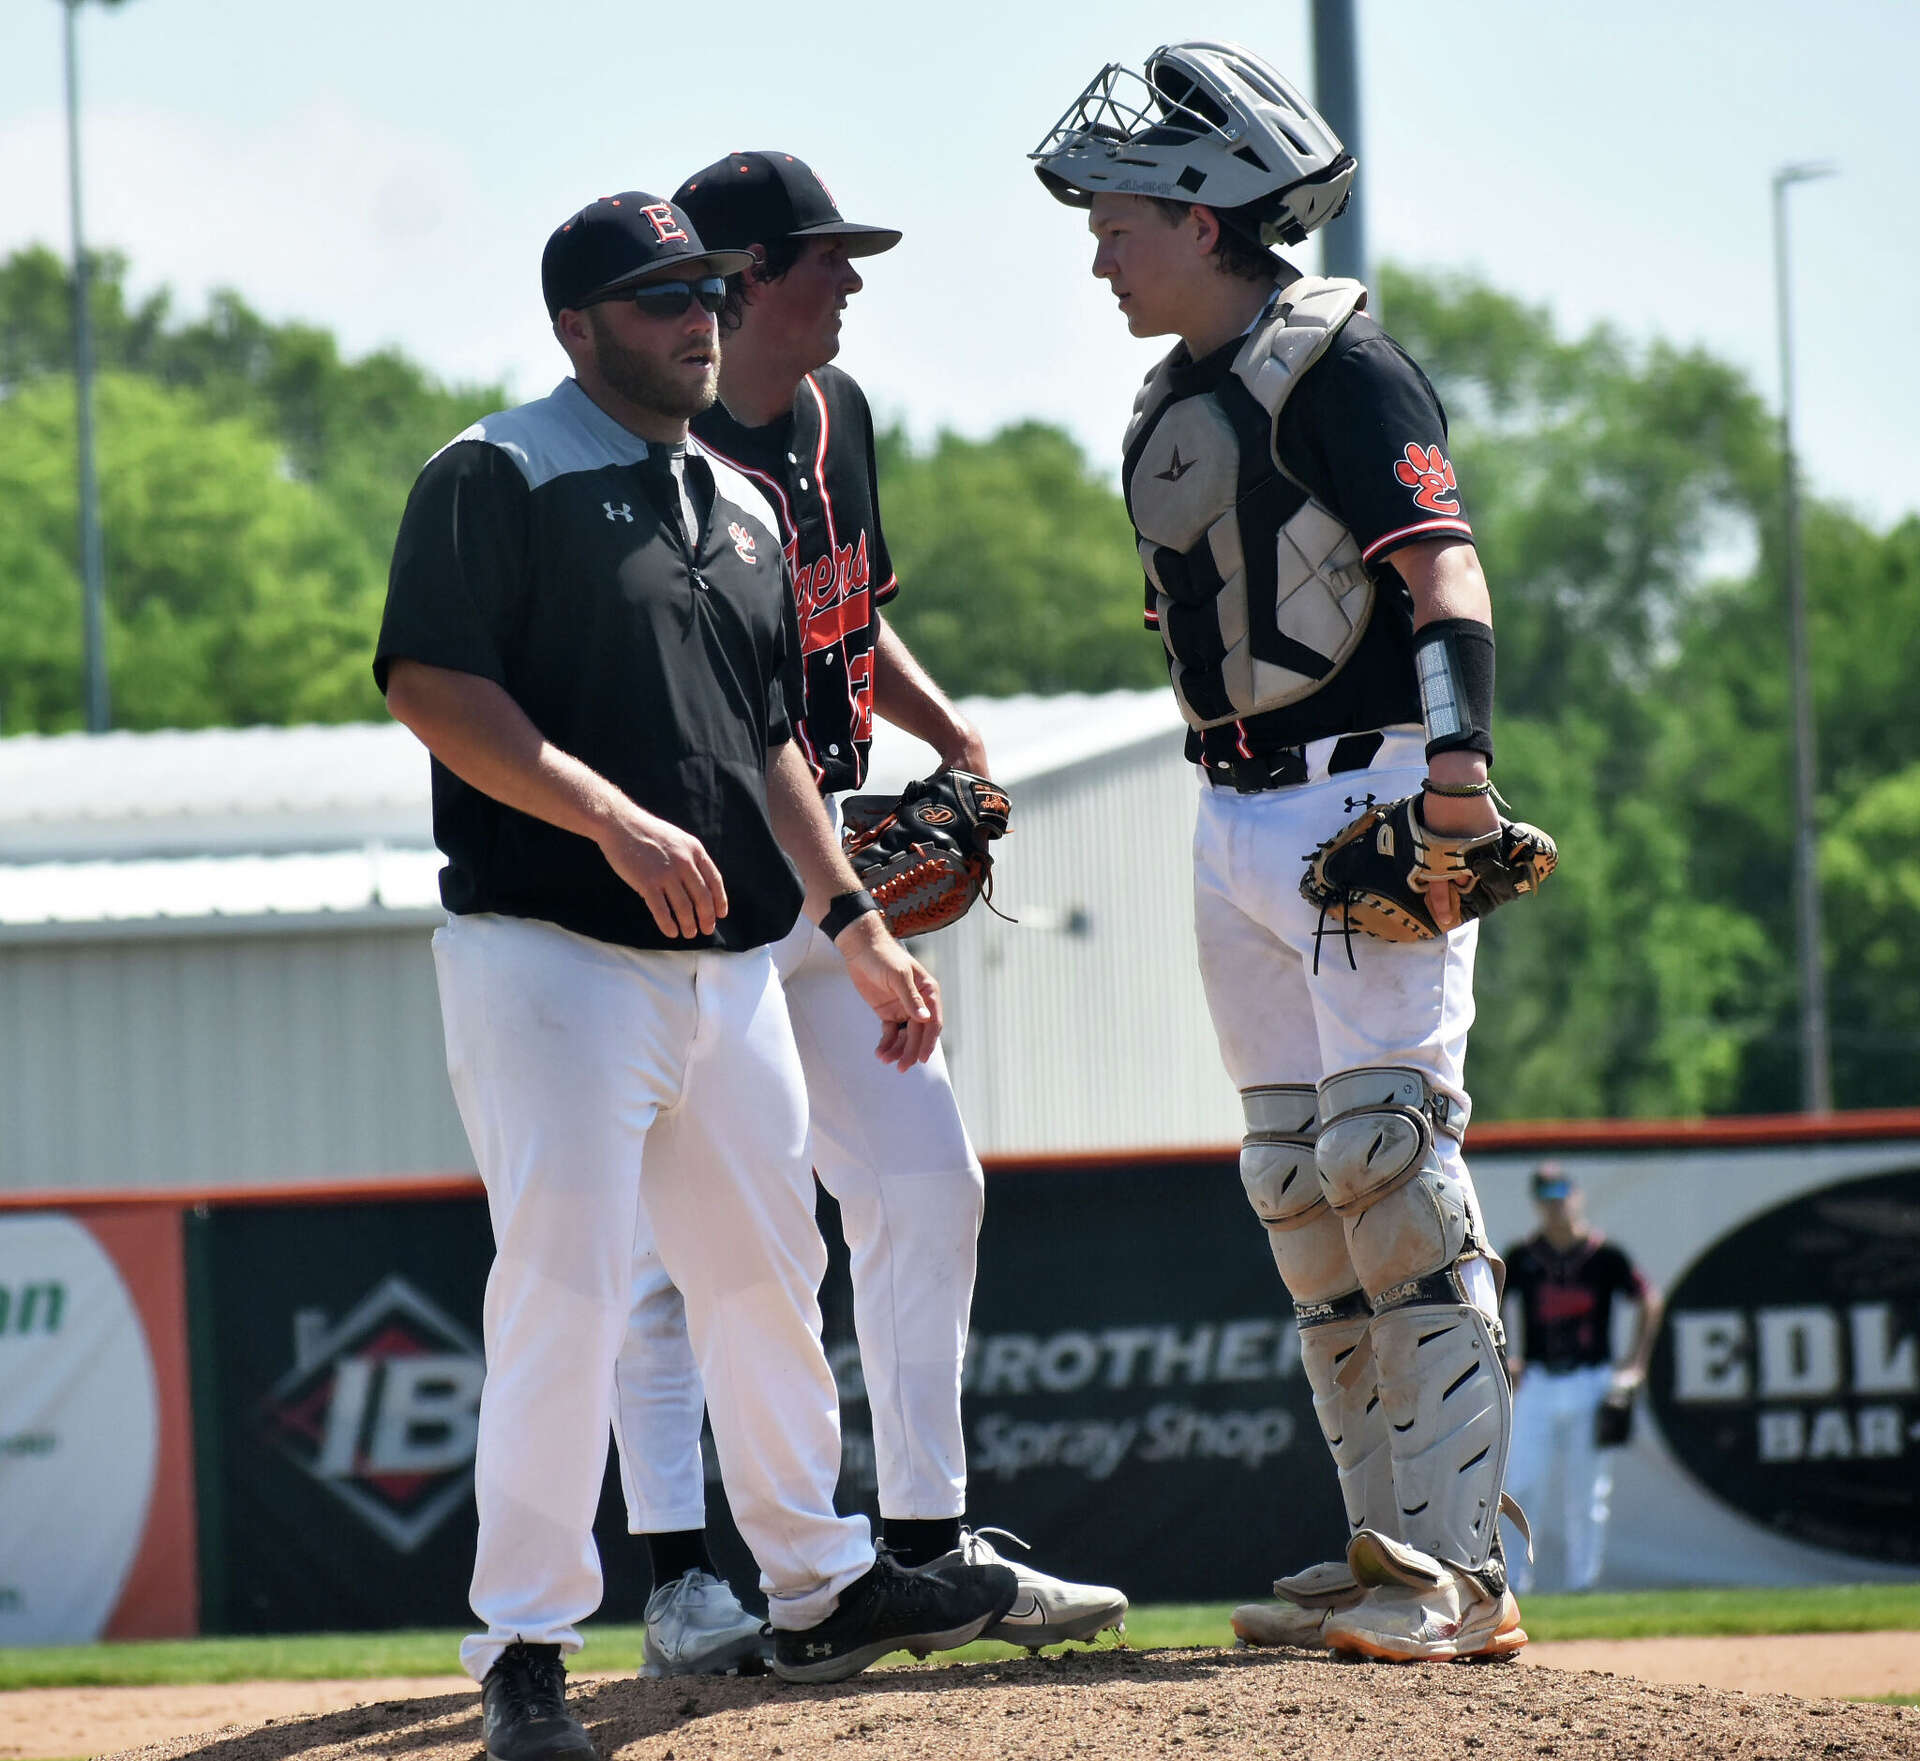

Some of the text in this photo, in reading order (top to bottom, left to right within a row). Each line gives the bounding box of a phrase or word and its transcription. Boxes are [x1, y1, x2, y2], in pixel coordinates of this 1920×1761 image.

[640, 202, 689, 245] E
[318, 1354, 487, 1477] IB
[974, 1402, 1297, 1480] Spray Shop
